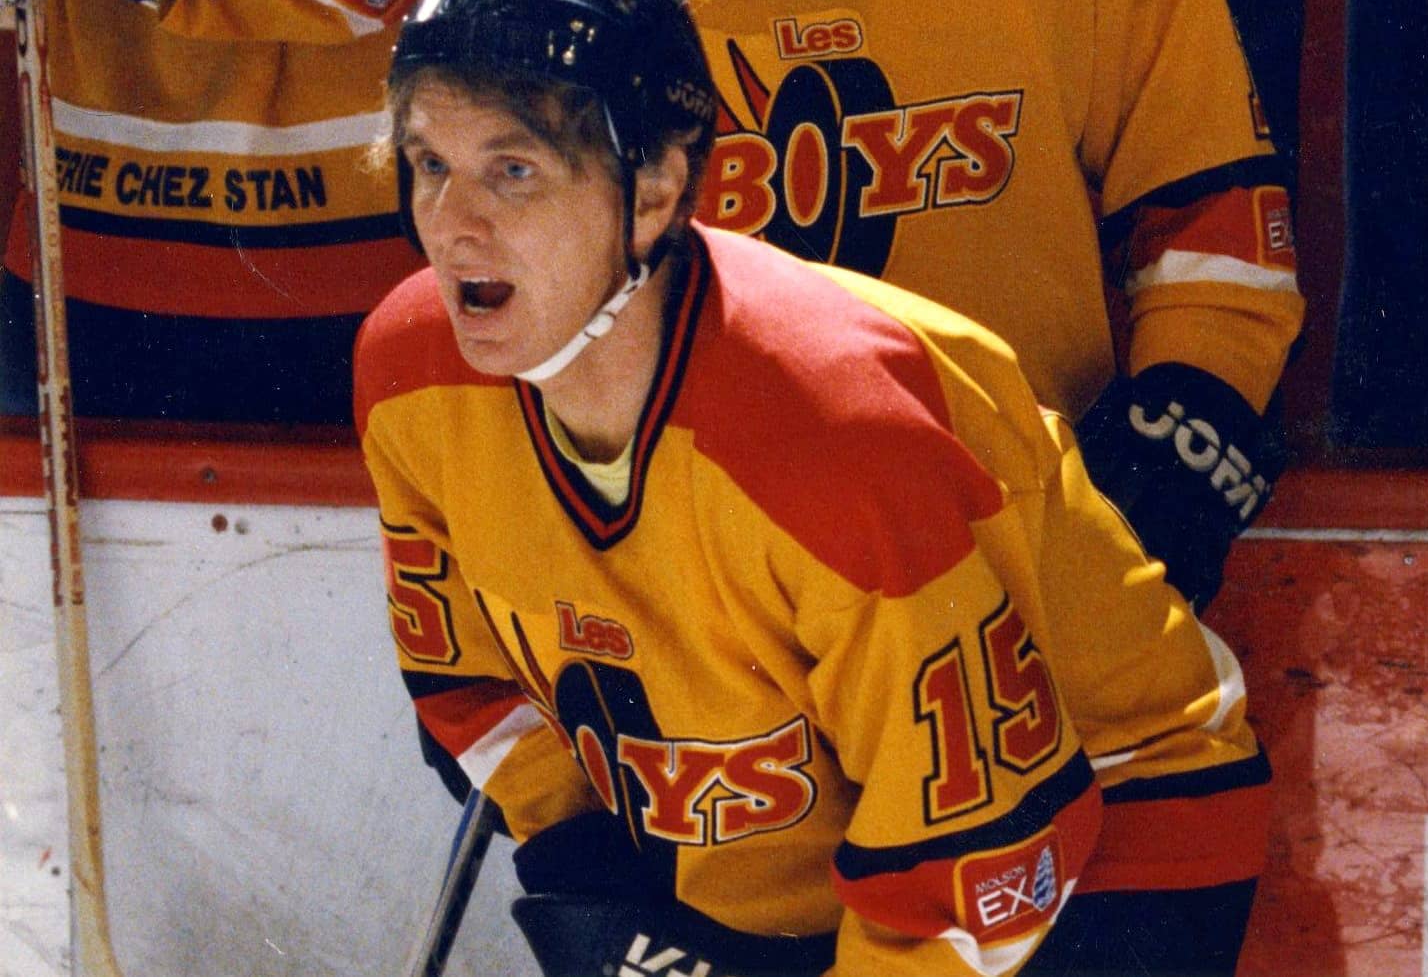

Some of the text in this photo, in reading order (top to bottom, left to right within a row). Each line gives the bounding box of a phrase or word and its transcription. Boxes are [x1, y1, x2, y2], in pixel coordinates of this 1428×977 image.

[775, 19, 861, 59] Les
[116, 163, 212, 207] CHEZ
[225, 166, 328, 211] STAN
[694, 91, 1022, 235] BOYS
[1129, 401, 1269, 520] JOFA
[555, 601, 633, 660] Les
[913, 593, 1062, 827] 15
[978, 874, 1034, 927] EX
